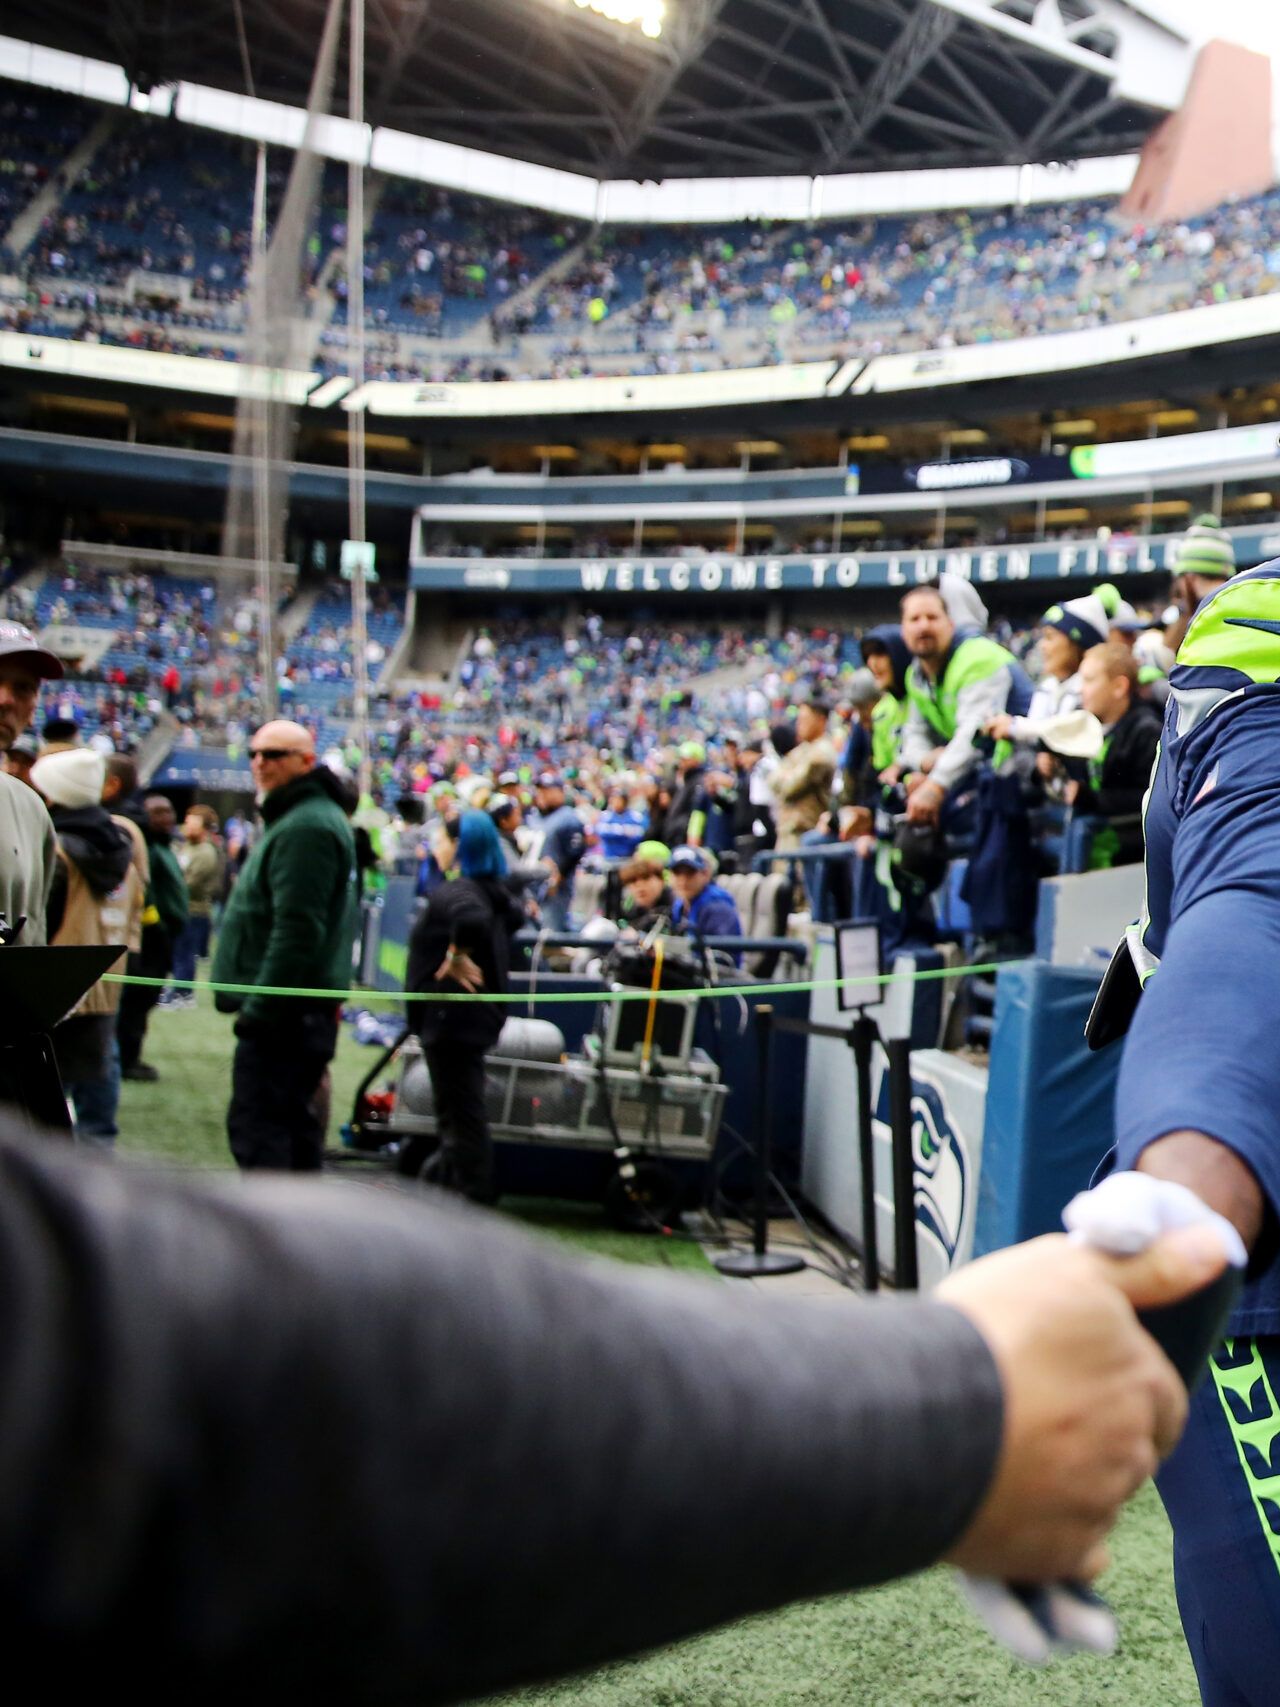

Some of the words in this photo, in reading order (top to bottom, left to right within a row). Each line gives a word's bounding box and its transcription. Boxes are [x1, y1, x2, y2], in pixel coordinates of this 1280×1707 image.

[580, 559, 783, 592] WELCOME
[810, 556, 860, 589] TO
[887, 548, 1031, 586] LUMEN
